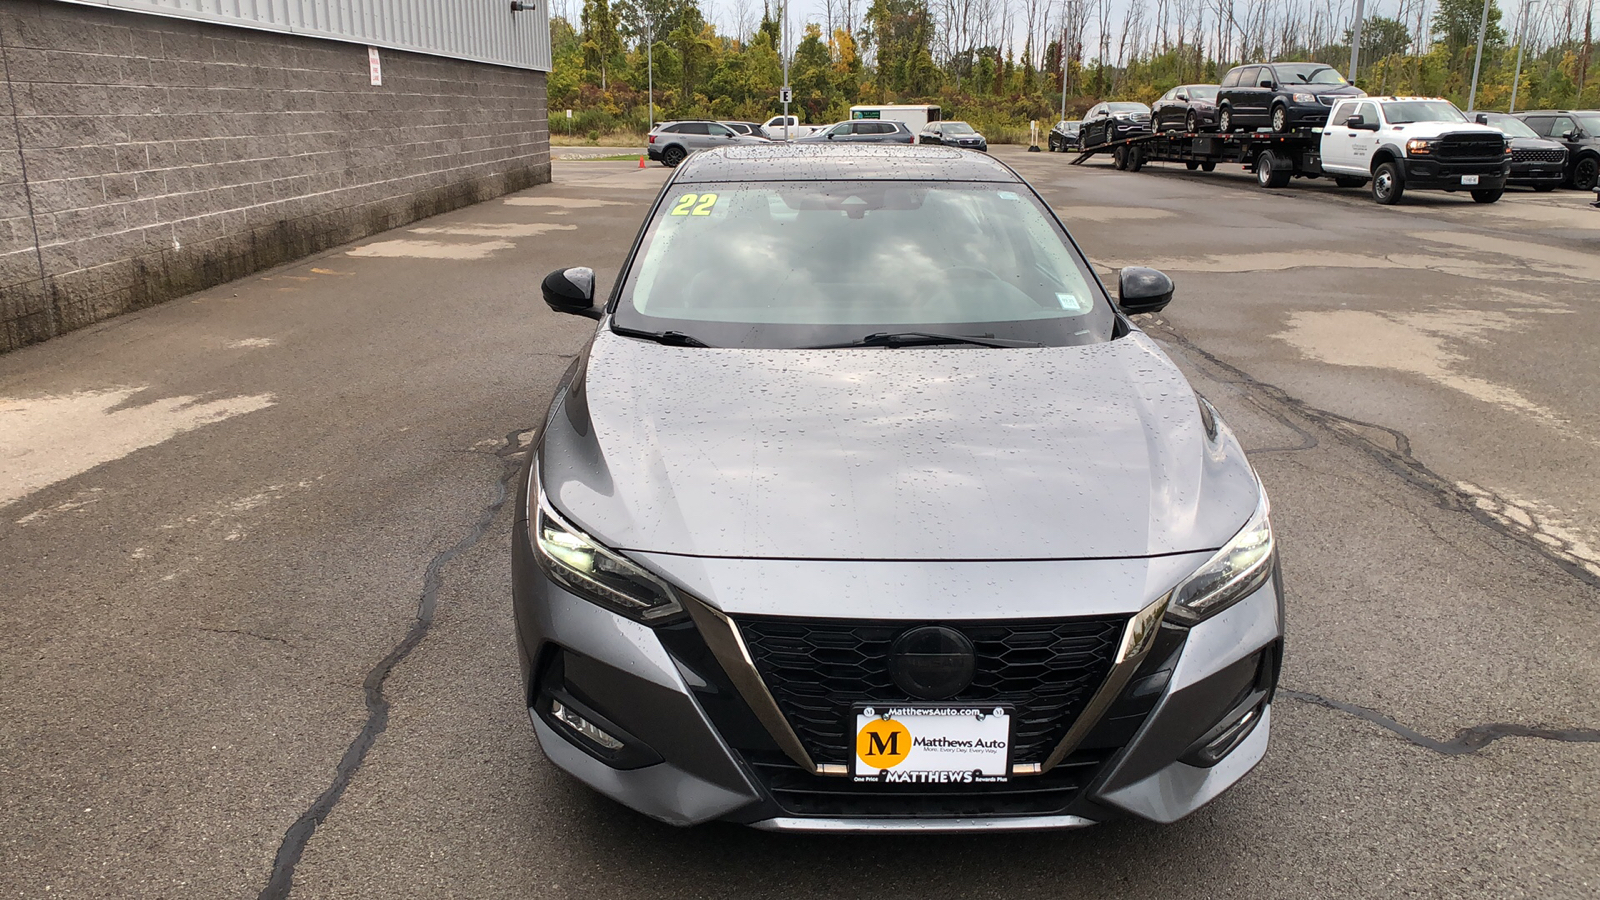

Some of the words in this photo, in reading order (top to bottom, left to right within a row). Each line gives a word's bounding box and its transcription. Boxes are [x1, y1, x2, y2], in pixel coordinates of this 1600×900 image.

[783, 91, 789, 102] E
[670, 193, 718, 216] 22
[888, 708, 980, 716] MatthewsAuto.com
[865, 731, 901, 755] M
[913, 736, 972, 748] Matthews
[974, 738, 1006, 749] Auto
[885, 771, 972, 783] MATTHEWS
